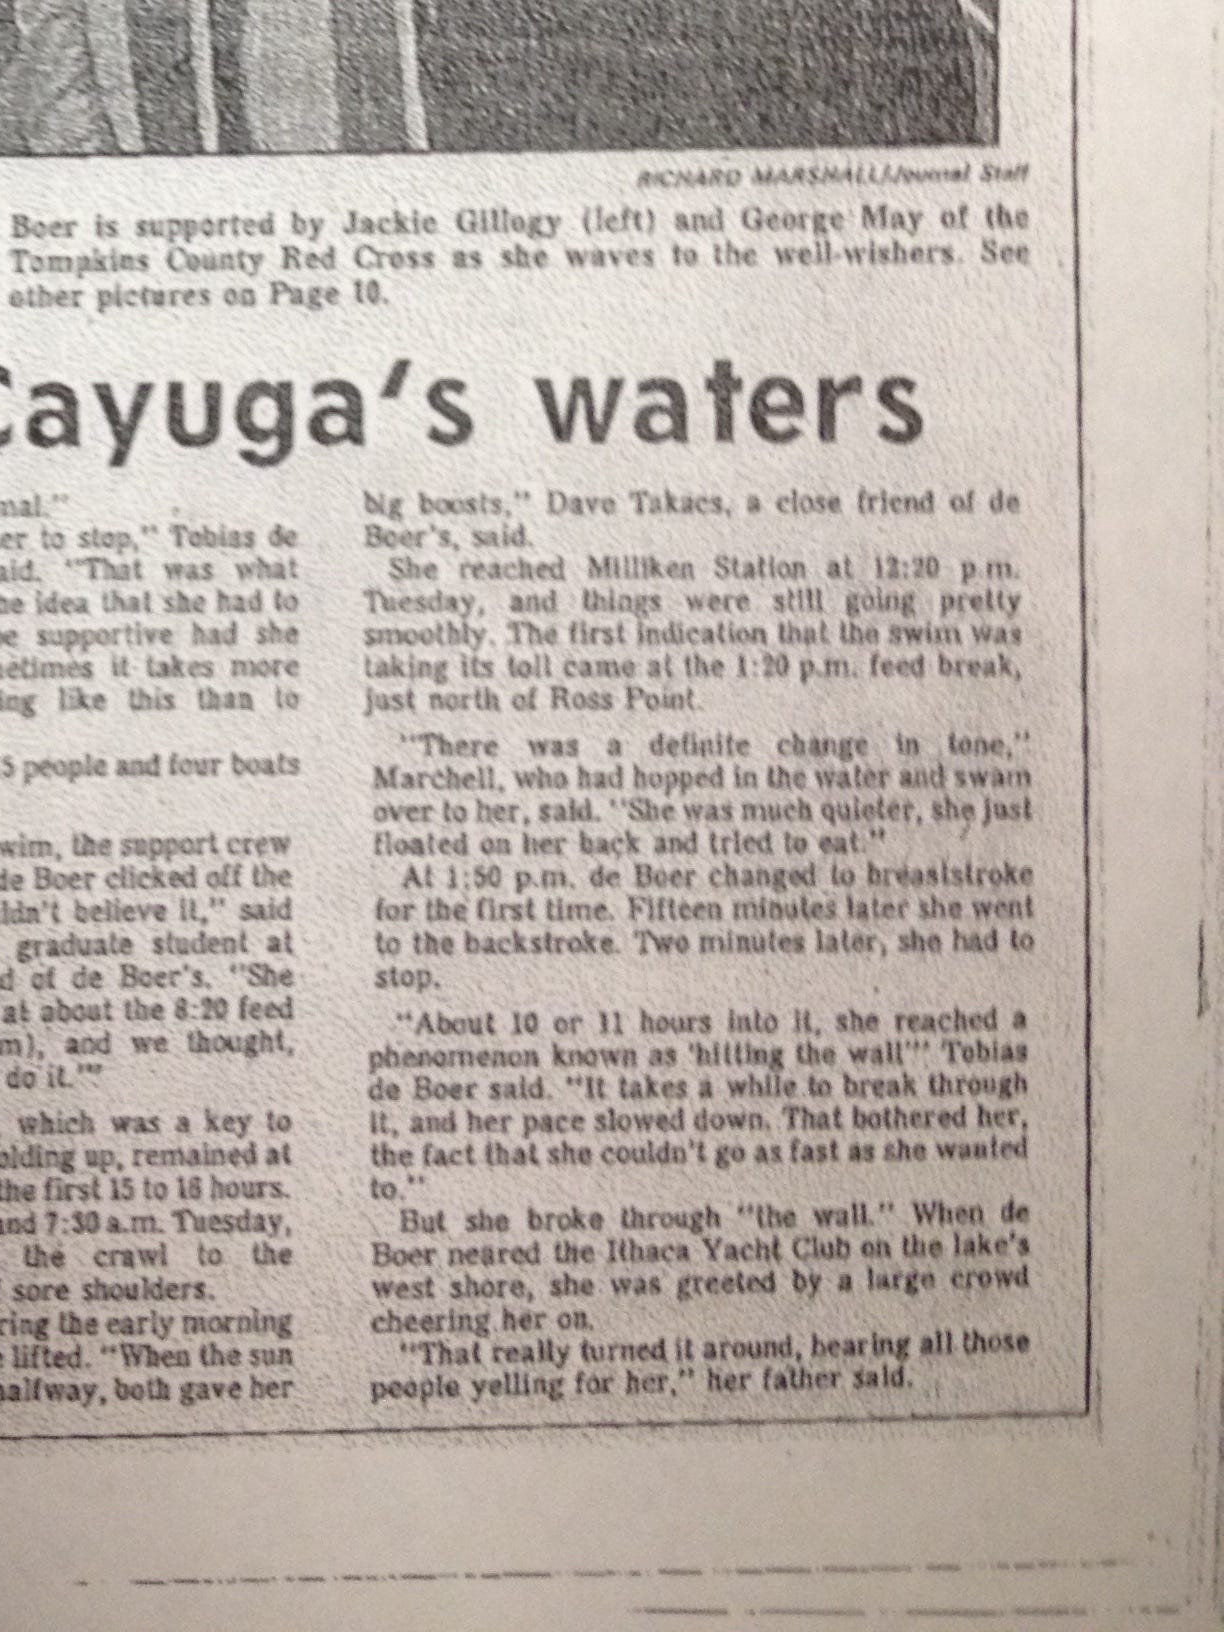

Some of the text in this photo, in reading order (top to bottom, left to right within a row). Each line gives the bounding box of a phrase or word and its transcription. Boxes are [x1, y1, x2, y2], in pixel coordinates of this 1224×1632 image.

[12, 202, 1028, 244] Boer is supported by Jackie Gillogy (left) and George May of the
[13, 238, 1027, 277] Tompkins County Red Cross as she waves to the well-wishers. See
[10, 278, 388, 312] other pictures on Page 10.
[535, 358, 925, 445] waters
[363, 652, 1022, 685] taking its toll came at the 1:20 p.m. feed break,
[364, 684, 703, 717] just north of Ross Point.
[17, 933, 133, 964] graduate
[153, 930, 247, 956] student
[267, 931, 293, 955] at
[66, 1032, 111, 1055] and
[132, 1035, 167, 1054] we
[188, 1029, 292, 1059] thought,
[370, 1105, 1028, 1139] it, and her pace slowed down. That bothered her,
[13, 1283, 70, 1302] sore
[83, 1277, 215, 1302] shoulders.
[372, 1265, 1029, 1301] west shore, she was greeted by a large crowd
[114, 1376, 170, 1402] both
[180, 1381, 242, 1407] gave
[250, 1375, 293, 1400] her
[371, 1364, 913, 1405] people yelling for her," her father said.
